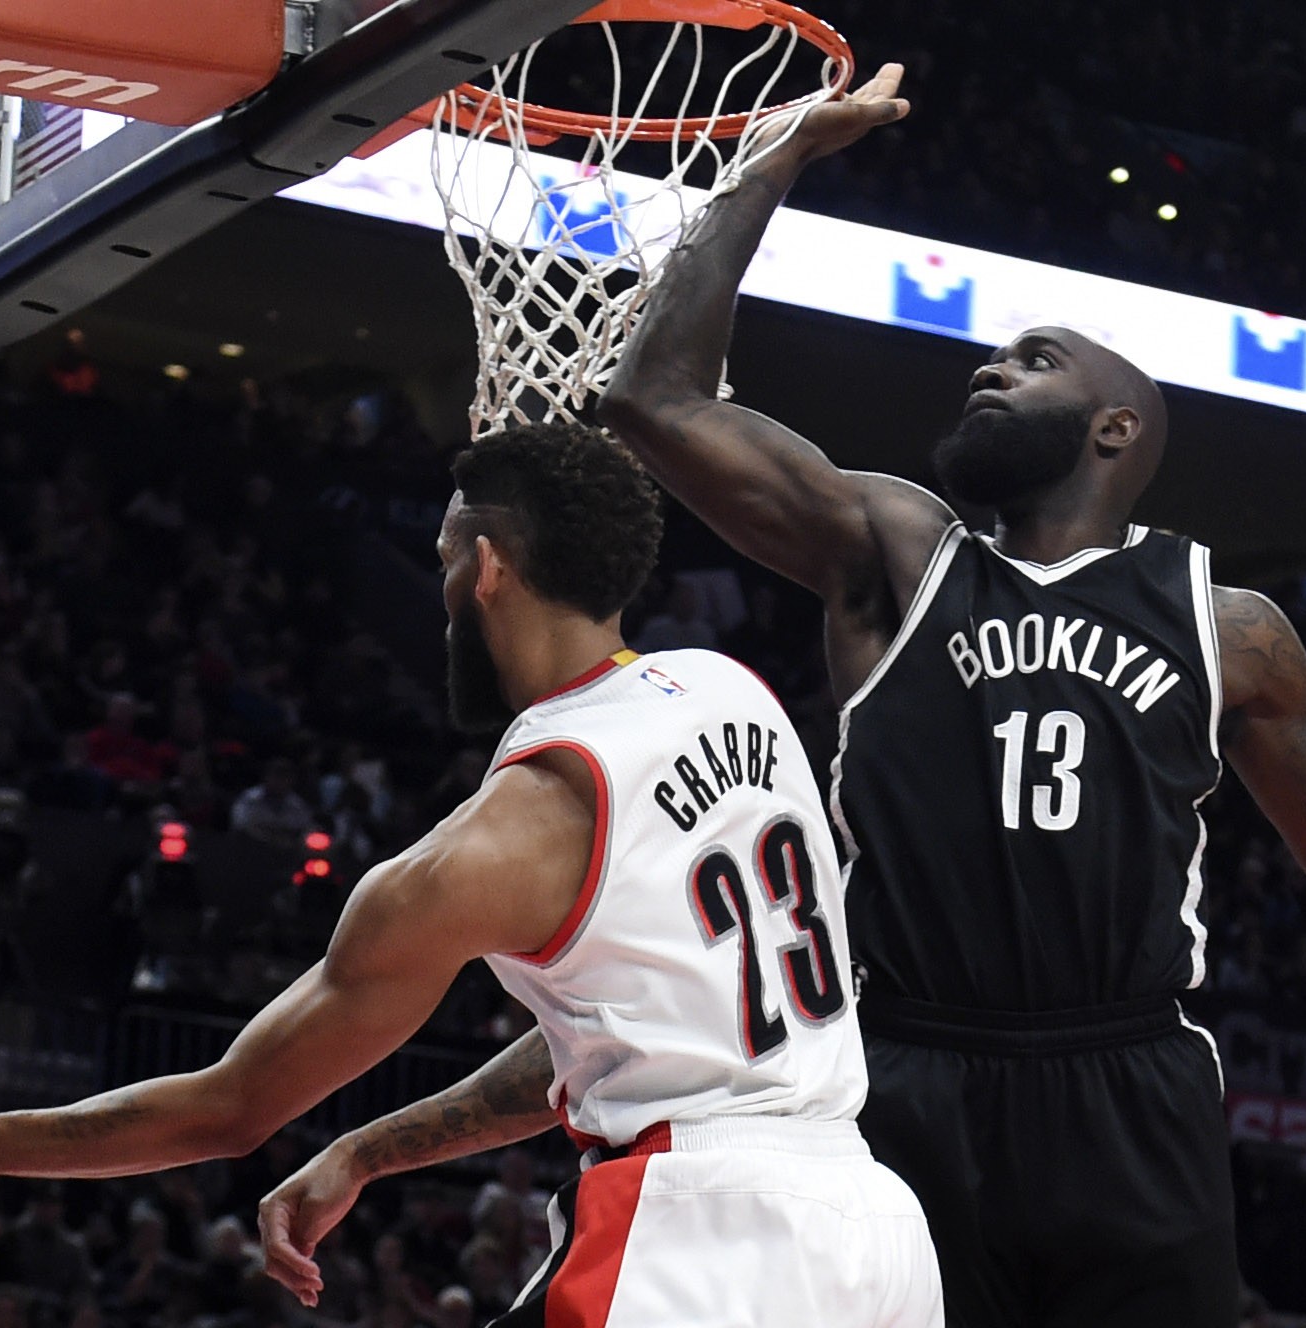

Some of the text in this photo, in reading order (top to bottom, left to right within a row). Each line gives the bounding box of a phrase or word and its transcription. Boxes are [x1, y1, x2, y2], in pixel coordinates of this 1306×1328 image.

[946, 613, 1181, 714] BOOKLYN
[653, 722, 778, 833] CRABBE
[993, 710, 1086, 831] 13
[686, 812, 848, 1067] 23
